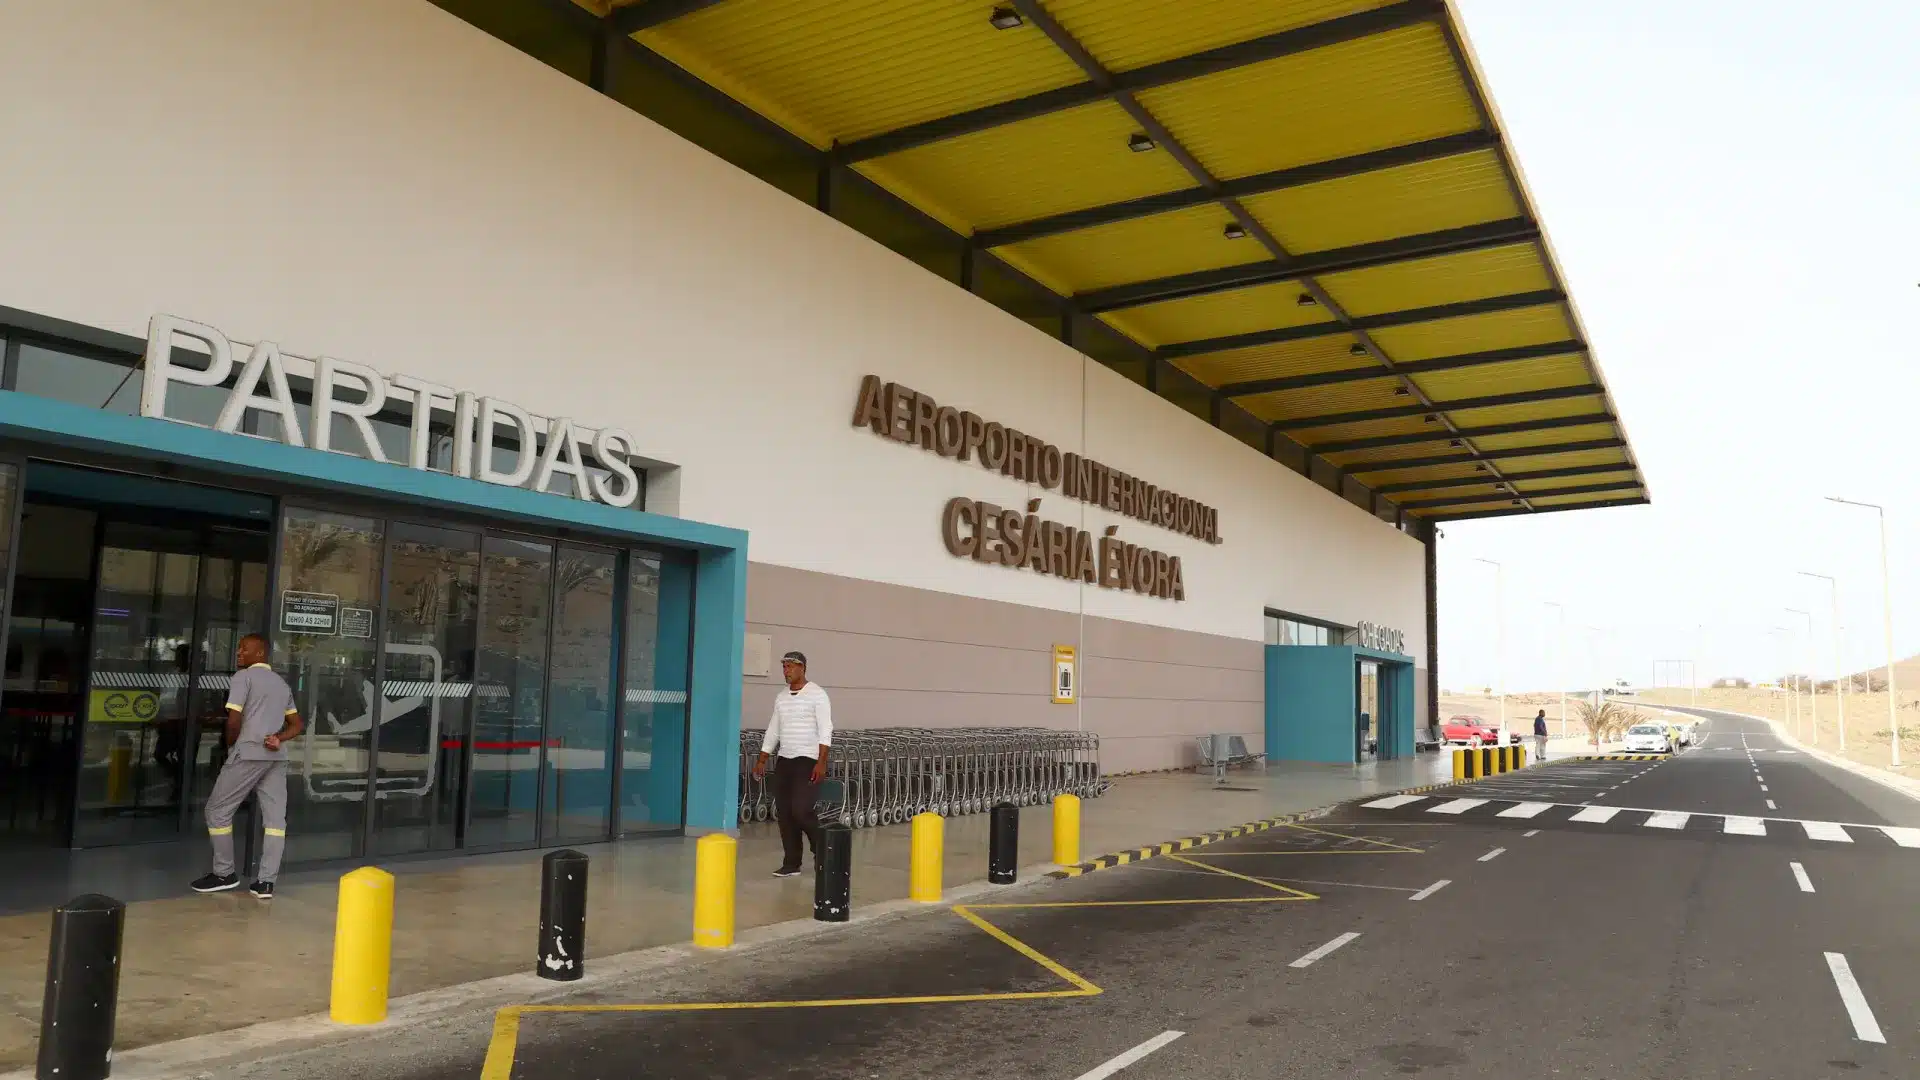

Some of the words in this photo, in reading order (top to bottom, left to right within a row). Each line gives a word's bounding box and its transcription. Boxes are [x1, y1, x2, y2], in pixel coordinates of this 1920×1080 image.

[139, 314, 638, 507] PARTIDAS
[852, 374, 1063, 489] AEROPORTO
[1063, 451, 1223, 545] INTERNACIONAL
[943, 497, 1097, 584] CESÁRIA
[1099, 525, 1186, 602] ÉVORA
[313, 617, 331, 626] 22H00
[1357, 620, 1405, 655] CHEGADAS
